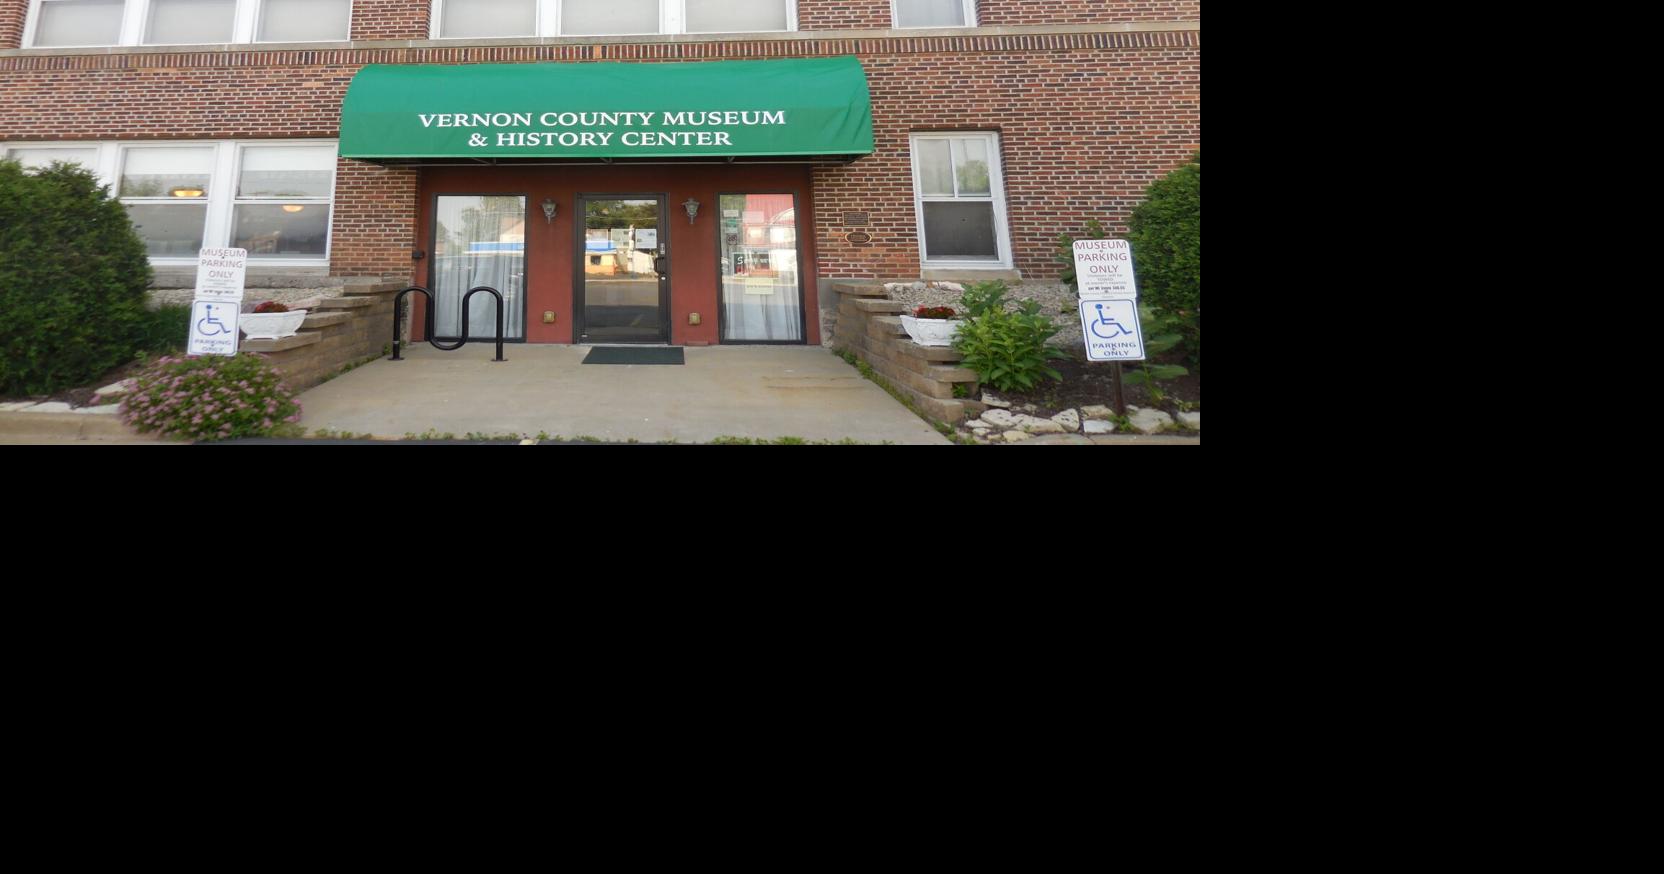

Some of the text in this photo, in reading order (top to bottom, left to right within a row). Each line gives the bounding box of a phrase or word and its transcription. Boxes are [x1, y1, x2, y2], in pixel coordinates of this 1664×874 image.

[418, 110, 786, 128] VERNON COUNTY MUSEUM
[468, 131, 733, 147] & HISTORY CENTER
[1074, 240, 1127, 250] MUSEUM
[201, 248, 246, 258] MUSEUM
[1078, 252, 1127, 262] PARKING
[201, 258, 243, 269] PARKING
[1090, 264, 1119, 274] ONLY
[208, 270, 234, 279] ONLY
[195, 338, 232, 346] PARKING
